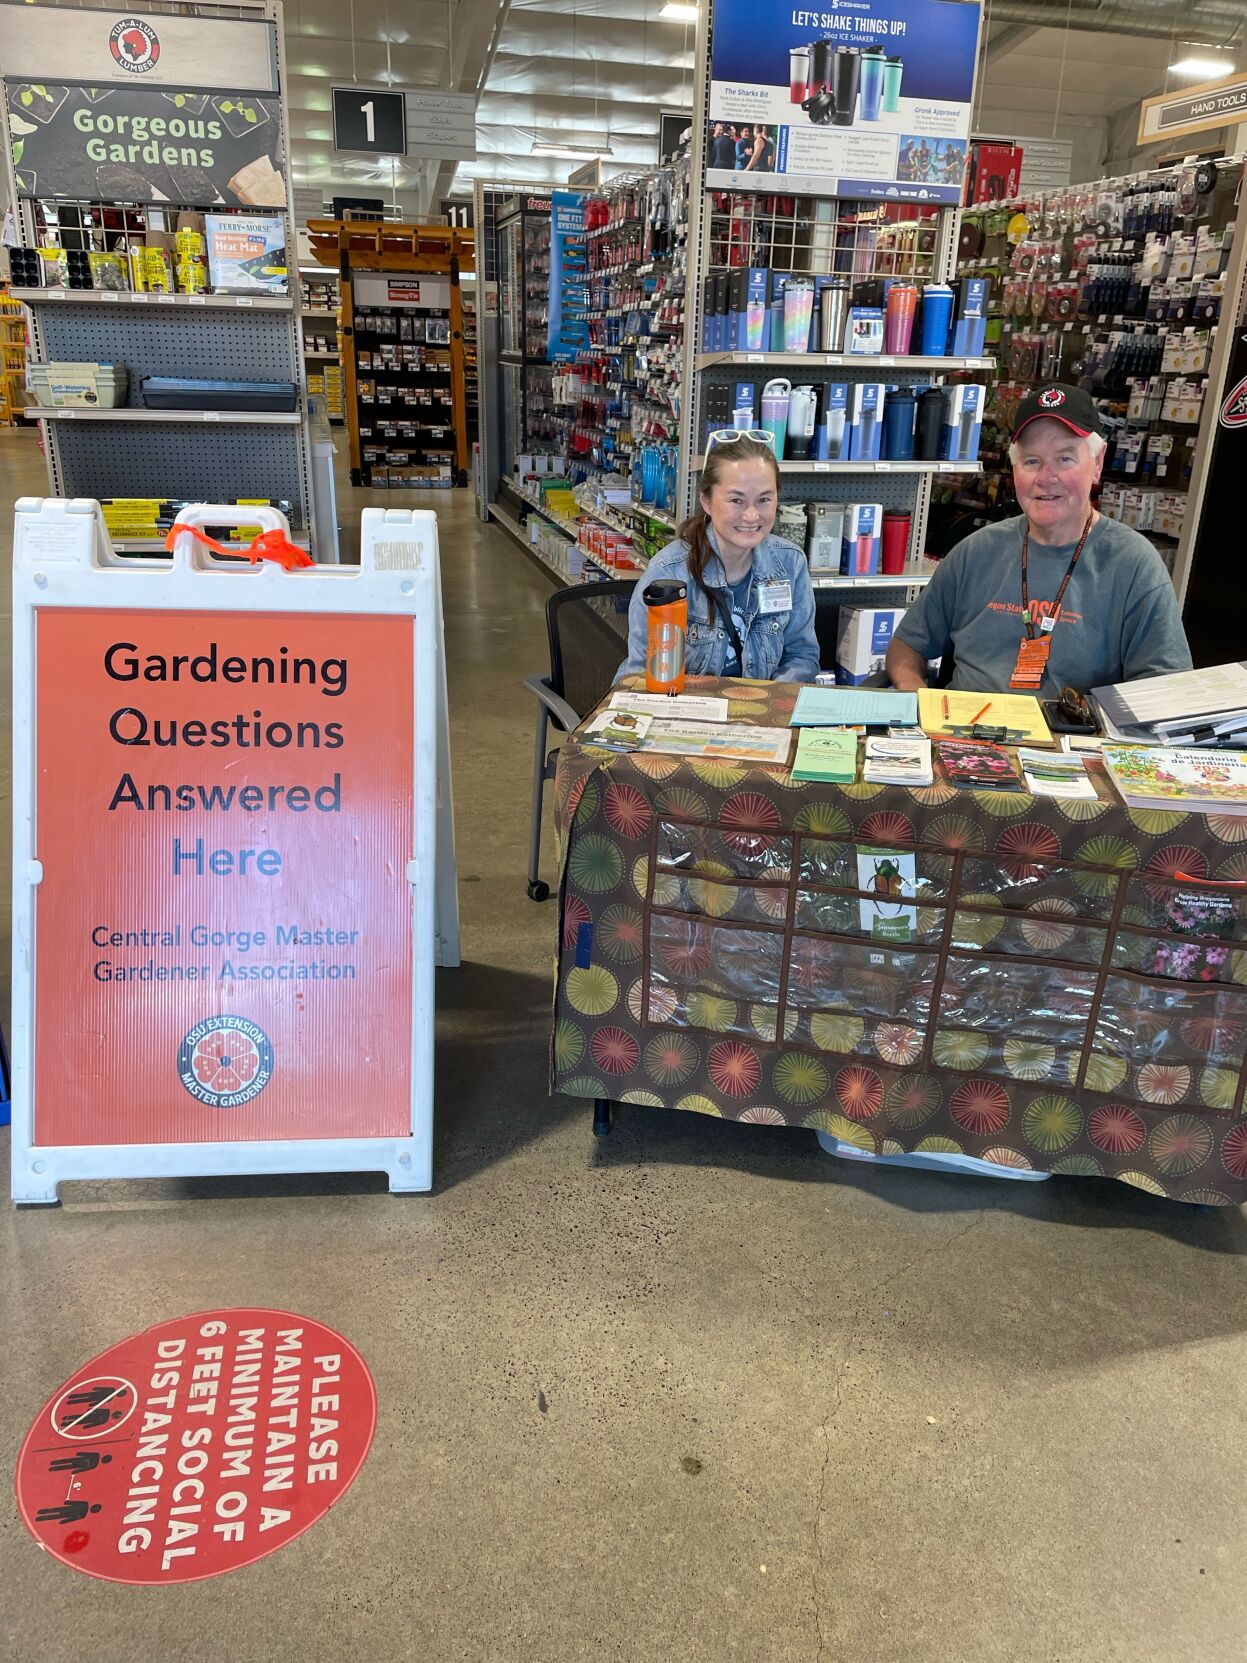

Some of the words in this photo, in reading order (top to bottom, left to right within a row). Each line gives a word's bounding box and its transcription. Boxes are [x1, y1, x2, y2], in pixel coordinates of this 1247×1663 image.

[111, 20, 156, 40] TUM-A-LUM
[792, 10, 819, 28] LET'S
[820, 14, 852, 31] SHAKE
[854, 17, 888, 34] THINGS
[890, 21, 907, 36] UP!
[850, 34, 874, 43] SHAKER
[119, 58, 154, 72] LUMBER
[725, 88, 737, 96] The
[738, 89, 759, 97] Sharks
[1190, 100, 1216, 115] HAND
[1217, 92, 1247, 108] TOOLS
[73, 108, 222, 141] Gorgeous
[360, 101, 375, 142] 1
[932, 108, 960, 118] Approved
[86, 138, 215, 168] Gardens
[448, 206, 468, 228] 11
[216, 241, 238, 252] Heat
[240, 242, 258, 252] Mat
[104, 642, 348, 696] Gardening
[109, 707, 344, 748] Questions
[1175, 752, 1238, 762] Calendario
[108, 772, 342, 812] Answered
[172, 838, 282, 876] Here
[1178, 892, 1198, 901] Helping
[92, 924, 181, 948] Central
[190, 925, 266, 952] Gorge
[276, 925, 358, 946] Master
[93, 960, 210, 982] Gardener
[219, 960, 356, 981] Association
[186, 1022, 206, 1046] OSU
[206, 1016, 265, 1044] EXTENSION
[181, 1072, 219, 1105] MASTER
[220, 1070, 270, 1107] GARDENER
[200, 1320, 226, 1338] 6
[186, 1346, 224, 1416] FEET
[220, 1328, 266, 1479] MINIMUM
[262, 1328, 304, 1493] MAINTAIN
[306, 1354, 340, 1484] PLEASE
[118, 1338, 187, 1554] DISTANCING
[160, 1428, 212, 1571] SOCIAL
[213, 1490, 248, 1542] OF
[258, 1506, 292, 1532] A
